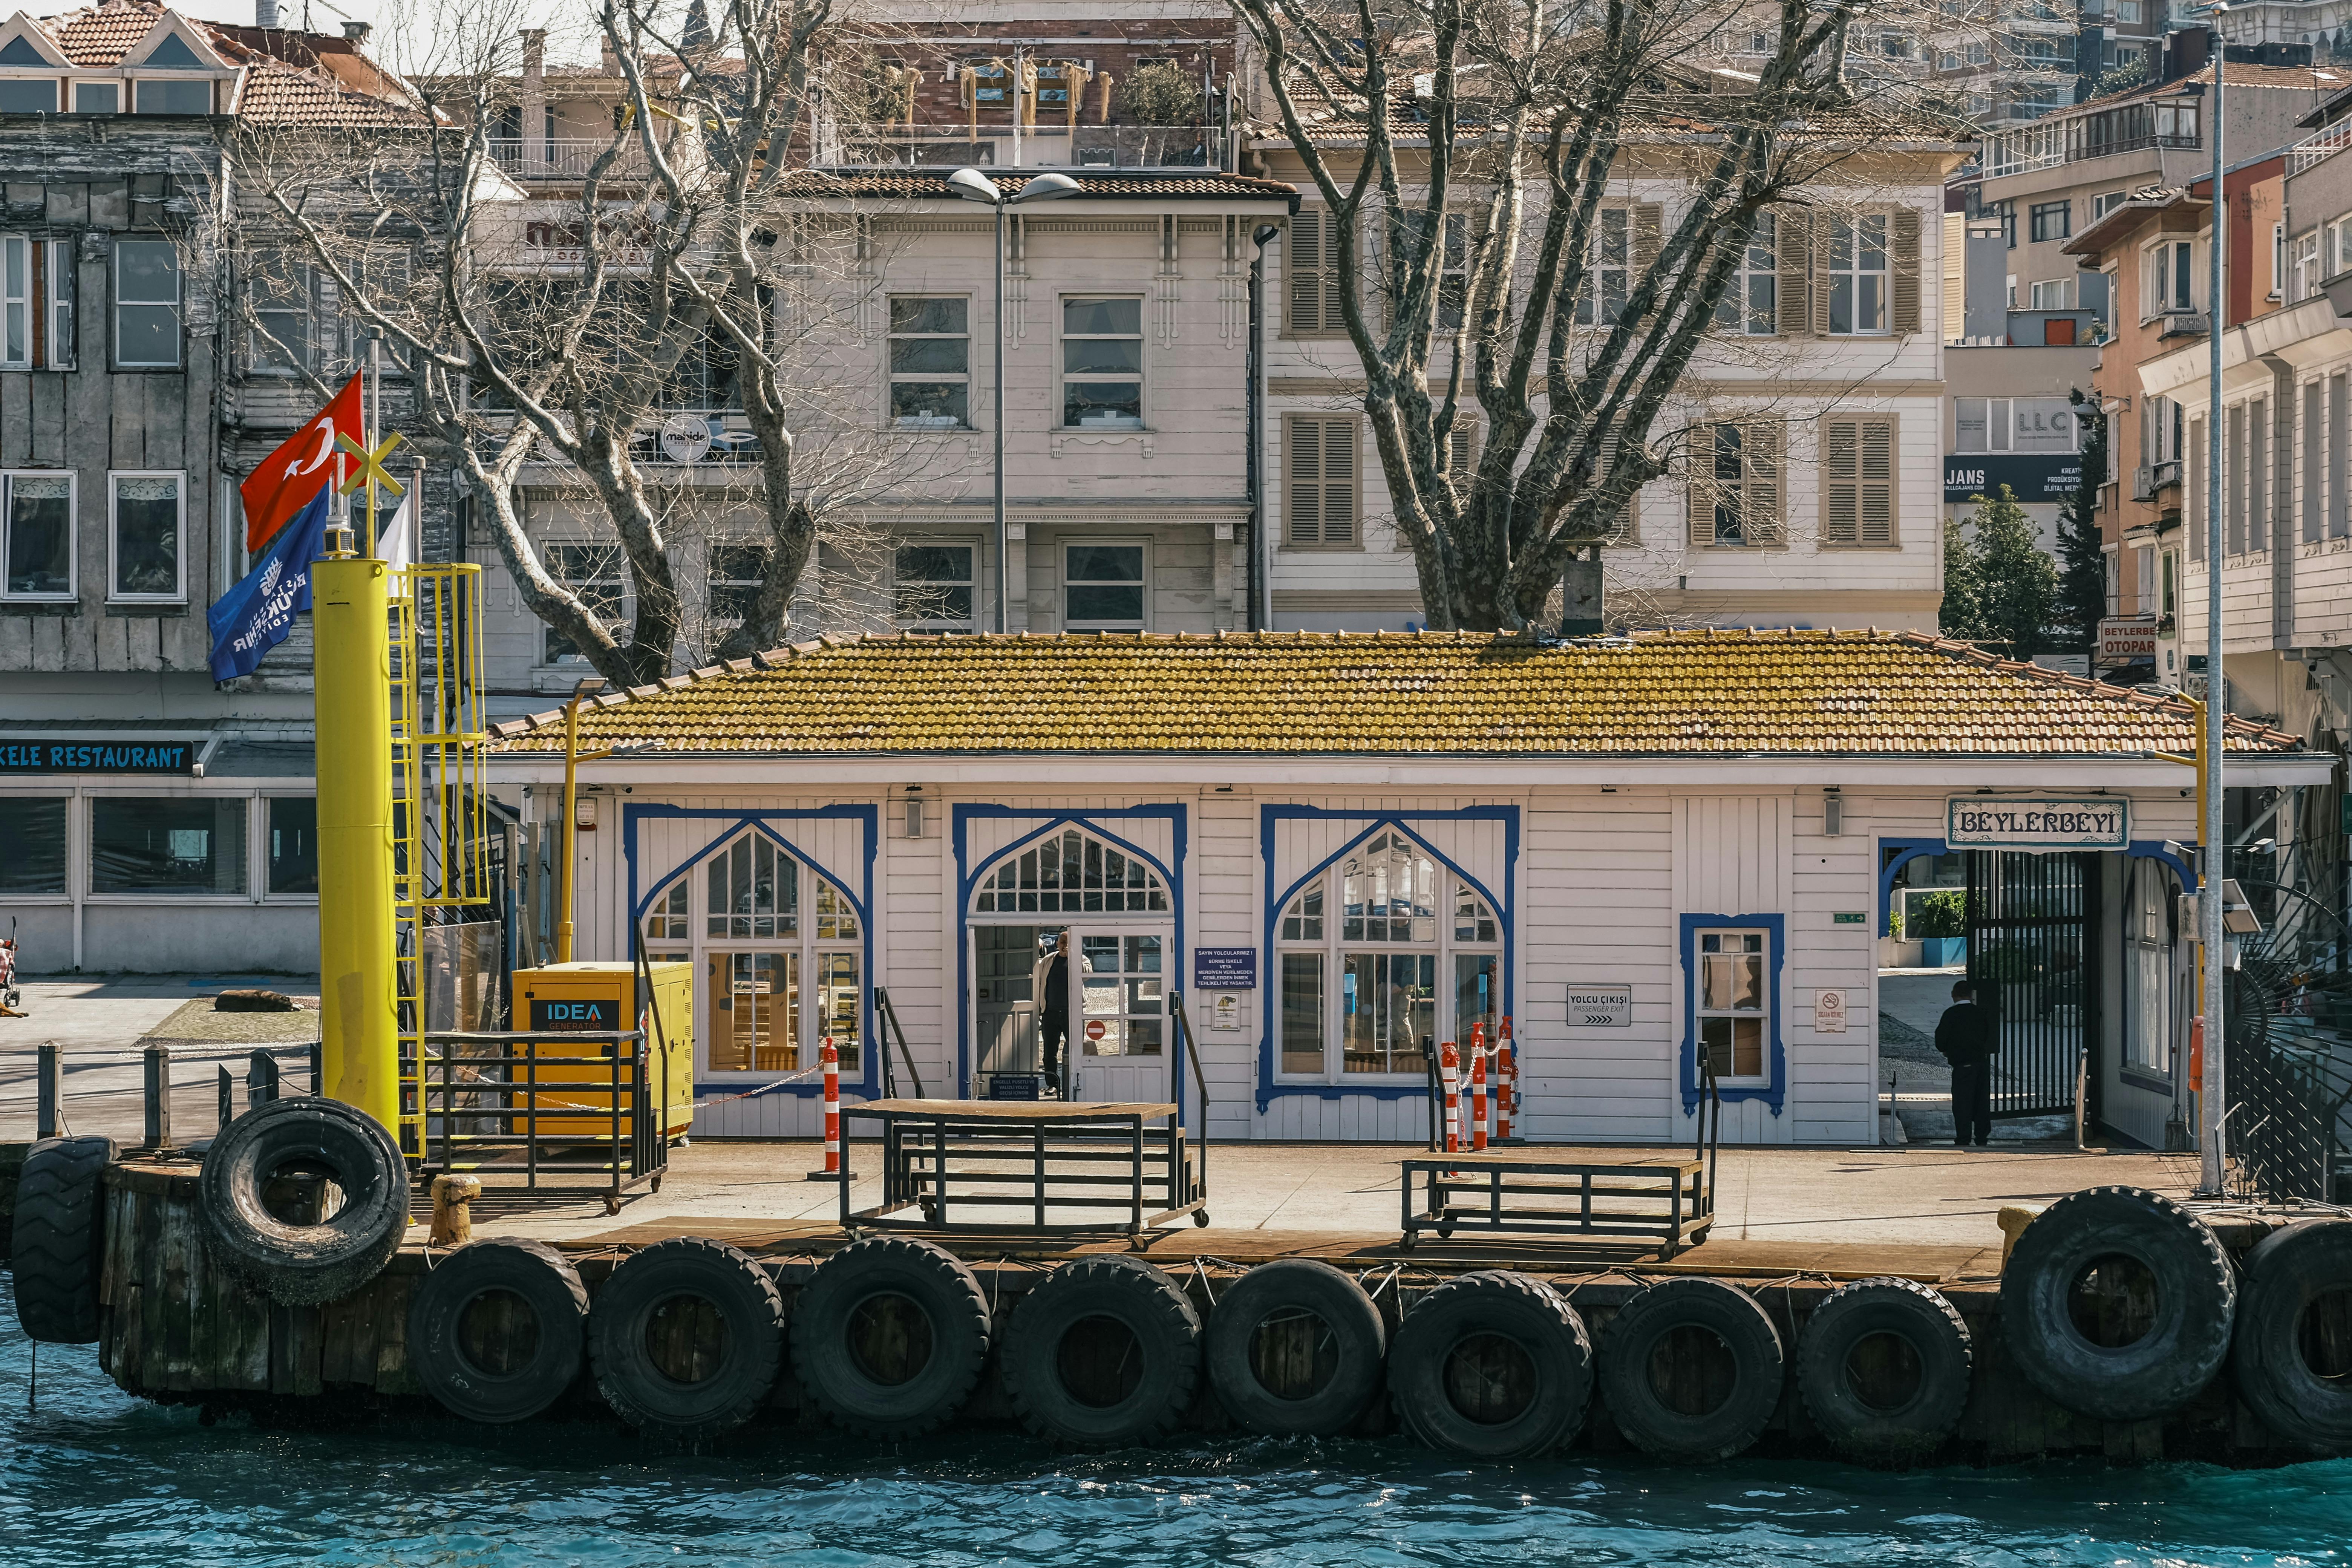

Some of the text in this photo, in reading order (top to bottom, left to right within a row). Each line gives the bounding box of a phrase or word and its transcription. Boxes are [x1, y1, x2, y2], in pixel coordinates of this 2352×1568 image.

[2019, 412, 2067, 431] LLC
[666, 431, 704, 441] mahide
[1944, 470, 1984, 484] JANS
[50, 746, 184, 767] RESTAURANT
[1960, 811, 2116, 833] BEYLERBEYİ
[1601, 996, 1627, 1006] ÇIKIŞI
[548, 1004, 602, 1020] IDEA
